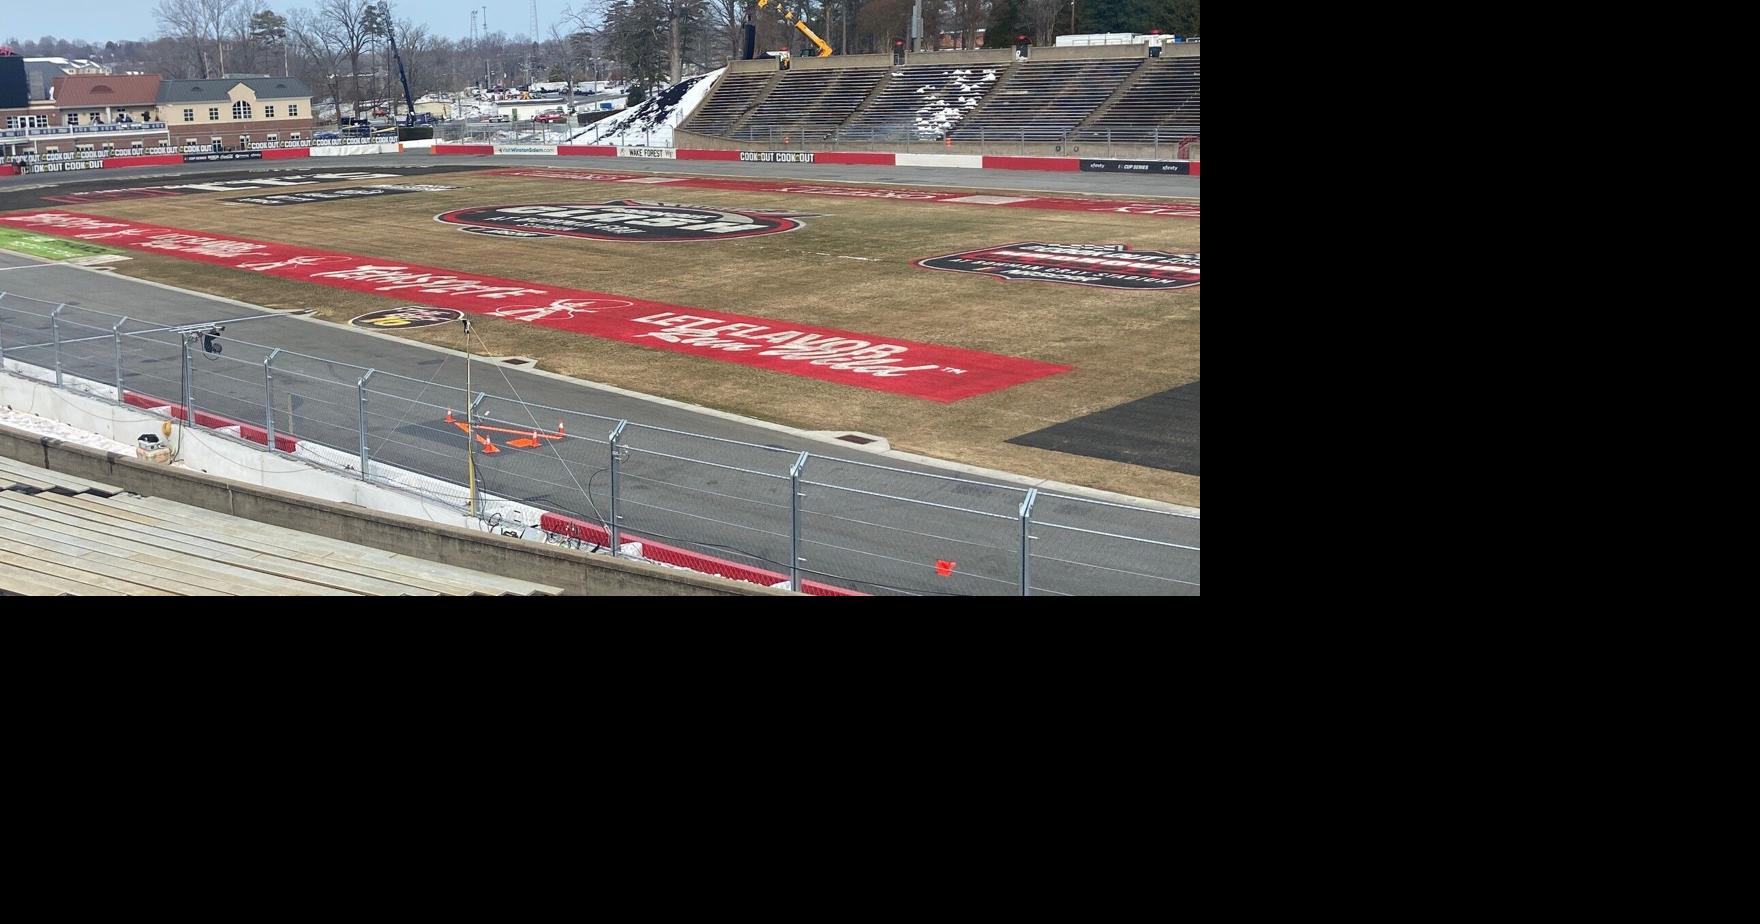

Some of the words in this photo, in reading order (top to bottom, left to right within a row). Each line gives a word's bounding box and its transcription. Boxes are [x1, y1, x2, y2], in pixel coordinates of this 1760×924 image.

[183, 145, 200, 153] COOK
[200, 144, 212, 152] OUT
[268, 141, 279, 149] OUT
[284, 140, 300, 148] COOK
[81, 150, 97, 159] COOK
[97, 149, 109, 158] OUT
[115, 148, 131, 156] COOK
[132, 148, 143, 156] OUT
[149, 146, 167, 155] COOK
[167, 146, 178, 154] OUT
[629, 148, 643, 157] WAKE
[644, 148, 663, 158] FOREST
[46, 152, 63, 161] COOK
[63, 151, 75, 159] OUT
[740, 151, 758, 161] COOK
[760, 152, 774, 162] OUT
[776, 152, 796, 162] COOK
[799, 153, 815, 163] OUT
[48, 162, 63, 172] OUT
[64, 162, 86, 171] COOK
[89, 160, 104, 169] OUT
[495, 205, 769, 233] CLASH
[971, 260, 1043, 271] BOWMAN
[1044, 267, 1091, 275] GRAY
[1092, 272, 1176, 284] STADIUM
[631, 312, 723, 330] LET
[717, 322, 909, 359] FLAVOR
[632, 326, 762, 352] Run
[758, 343, 940, 377] Wild
